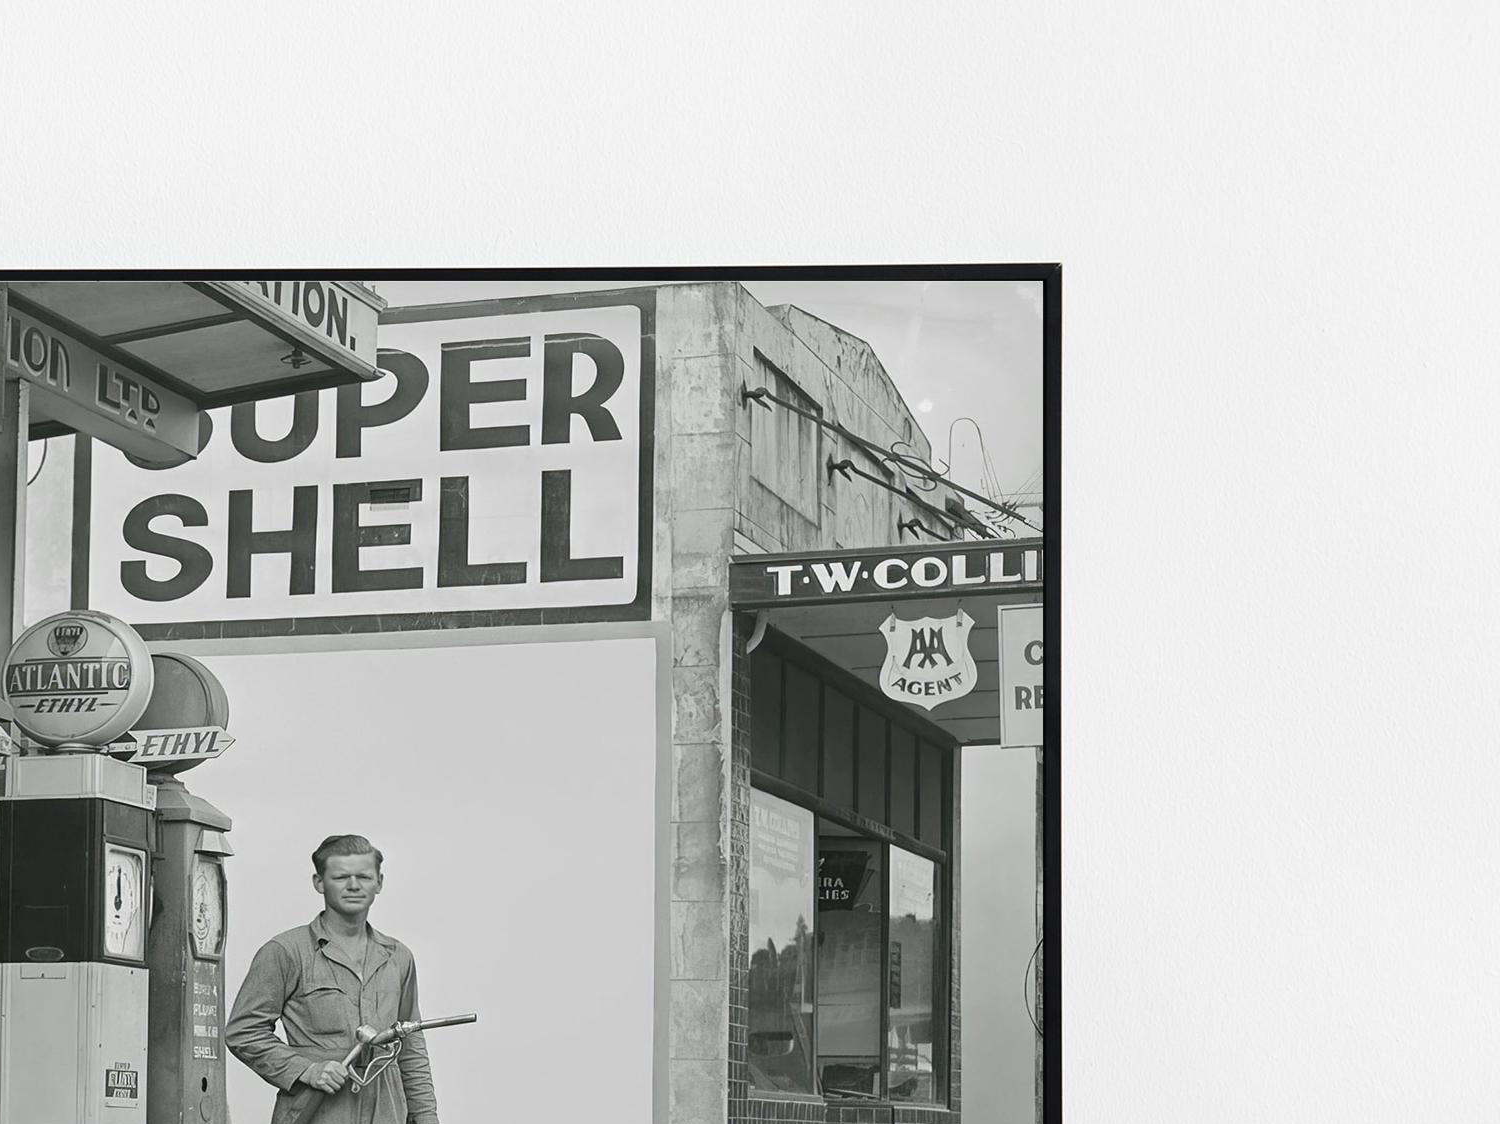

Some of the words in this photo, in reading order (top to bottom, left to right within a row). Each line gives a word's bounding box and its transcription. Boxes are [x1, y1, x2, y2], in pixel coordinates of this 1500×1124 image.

[120, 468, 625, 602] SHELL
[9, 662, 129, 692] ATLANTIC
[891, 671, 963, 696] AGENT
[33, 697, 100, 714] ETHYL
[140, 731, 219, 757] ETHYL
